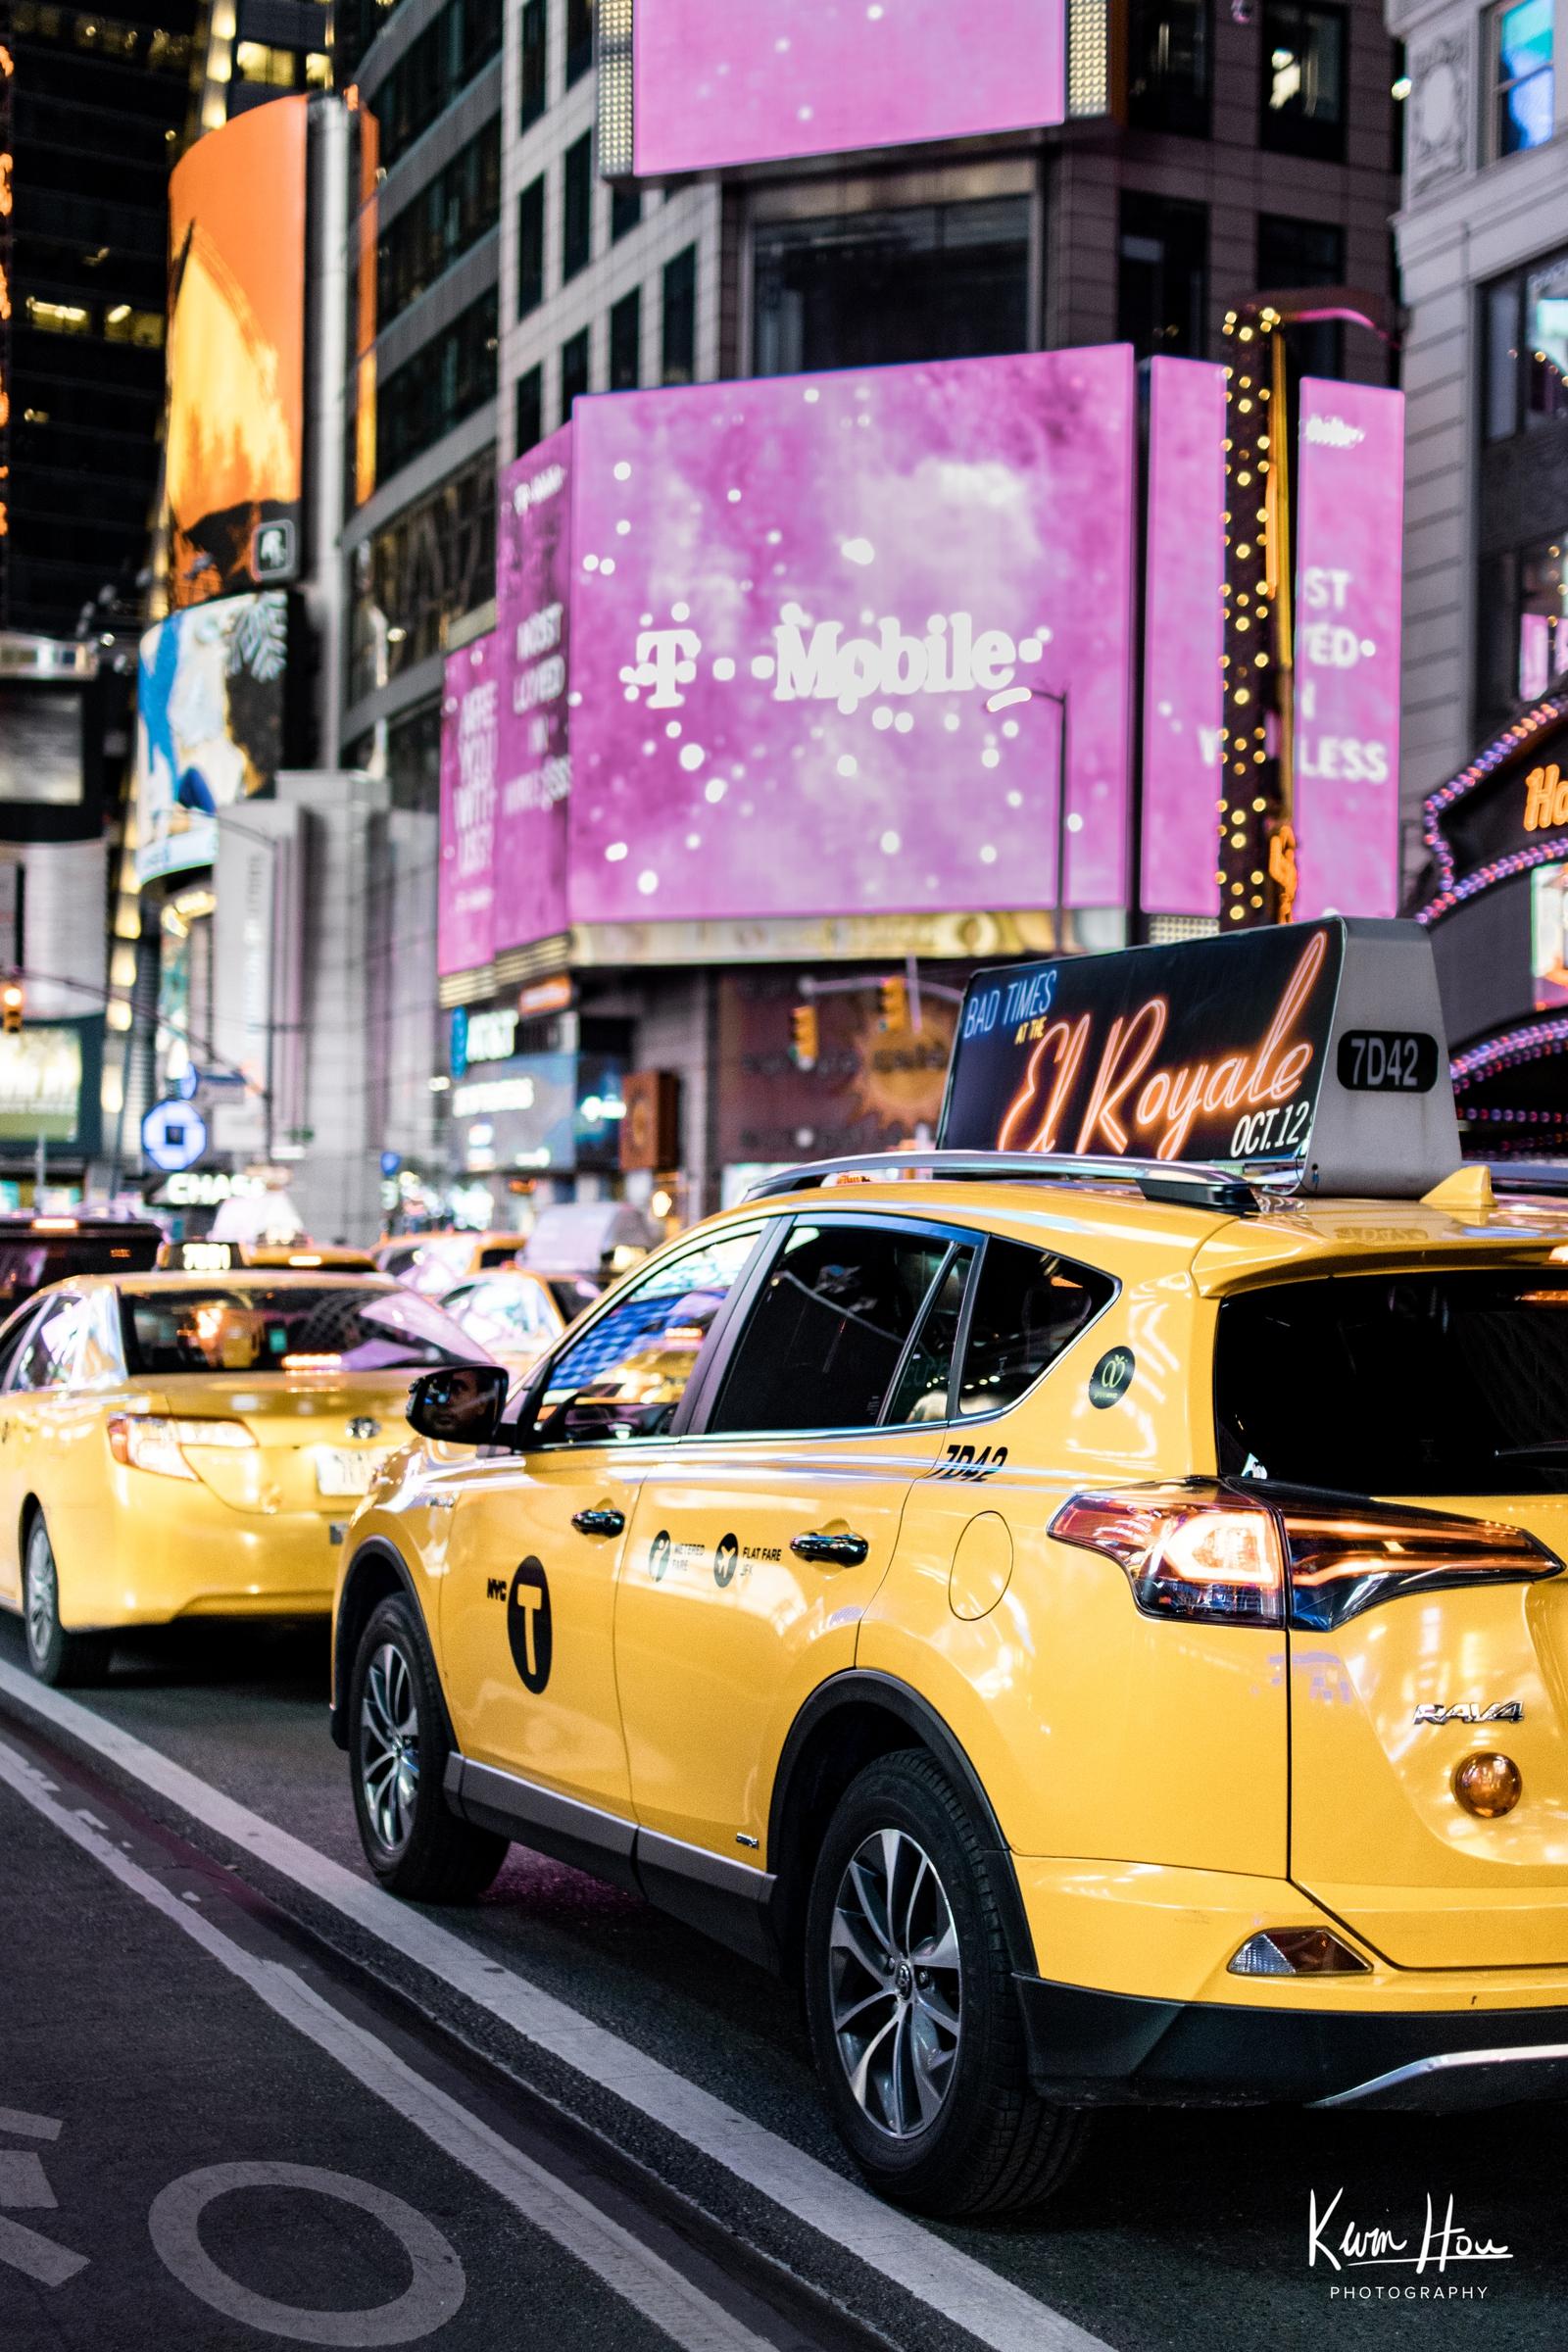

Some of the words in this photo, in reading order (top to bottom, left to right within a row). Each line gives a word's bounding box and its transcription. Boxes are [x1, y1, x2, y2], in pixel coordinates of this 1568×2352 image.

[962, 990, 1001, 1039] BAD
[1003, 969, 1057, 1022] TIMES
[998, 1012, 1092, 1154] El
[1076, 929, 1327, 1160] Royale
[1014, 1022, 1028, 1046] AT
[1028, 1017, 1047, 1042] THE
[1350, 1037, 1420, 1088] 7D42
[930, 1445, 1008, 1483] 7D42
[742, 1545, 760, 1560] FLAT
[761, 1547, 782, 1563] FARE
[486, 1578, 507, 1602] NYC
[1413, 1700, 1525, 1725] RAV4
